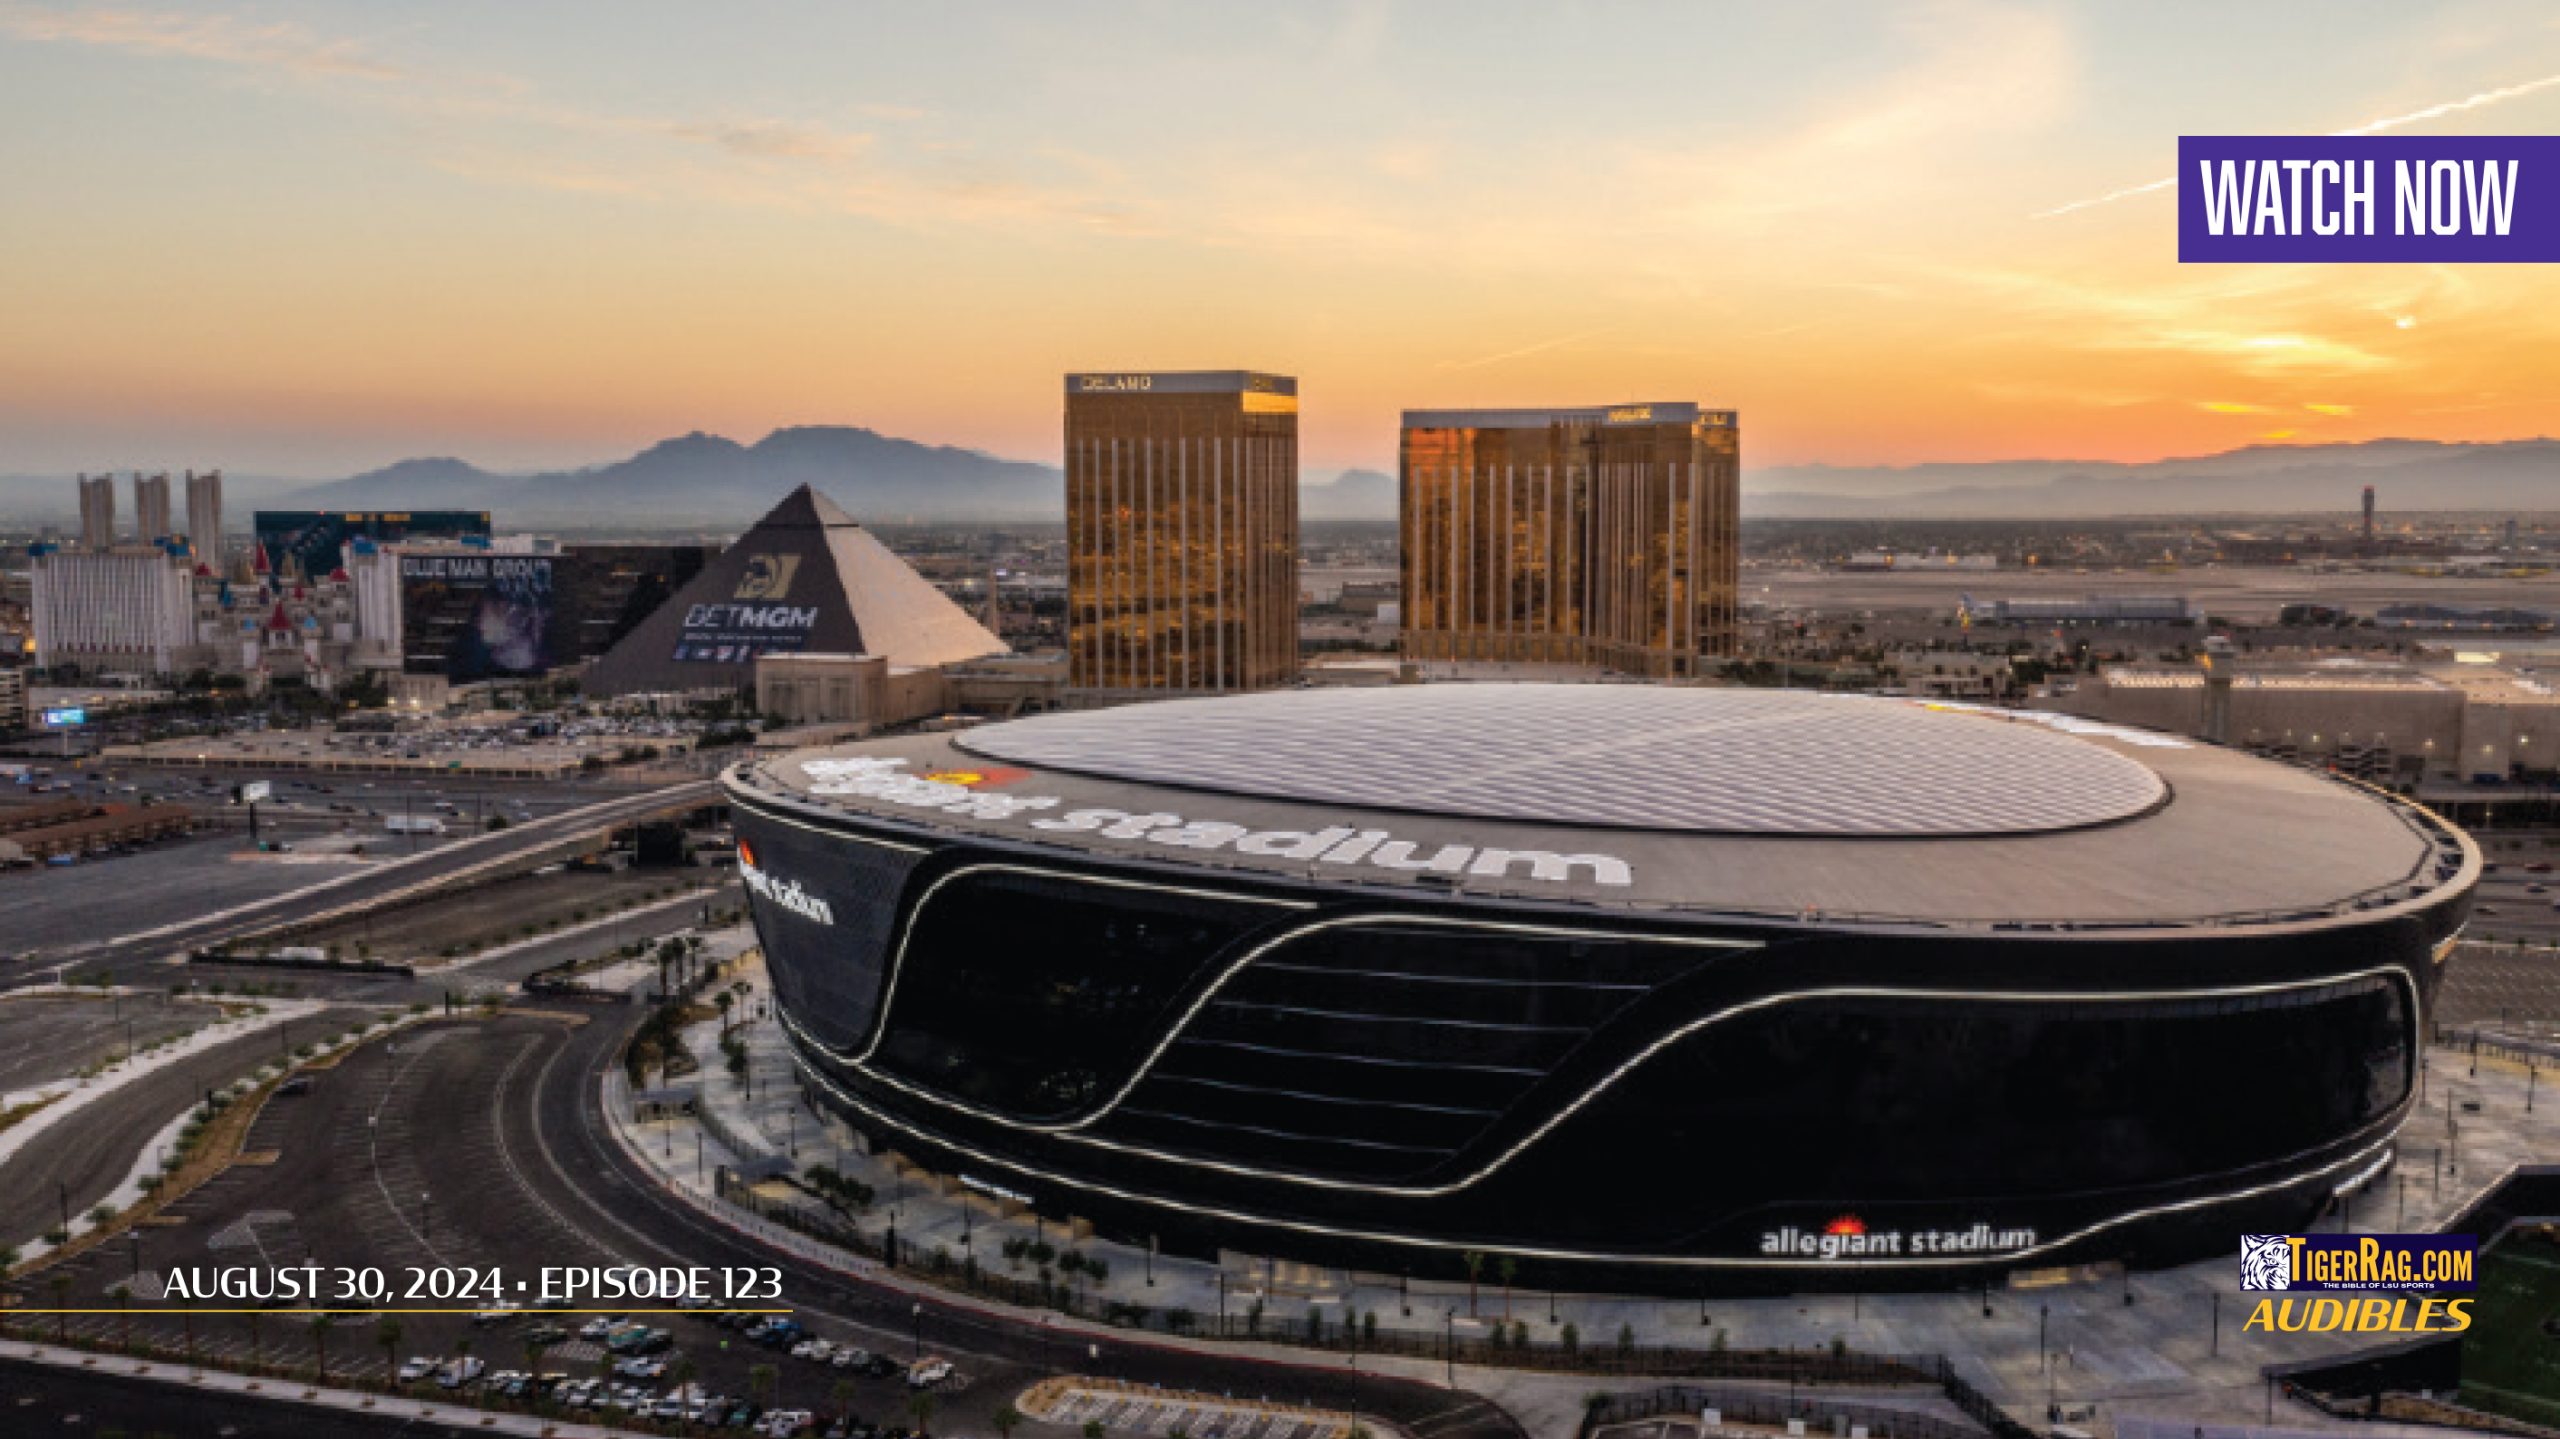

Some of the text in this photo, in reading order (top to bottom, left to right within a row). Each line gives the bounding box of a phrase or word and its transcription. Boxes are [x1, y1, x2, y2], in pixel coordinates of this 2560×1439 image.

[403, 558, 446, 576] BLUE
[449, 558, 487, 577] MAN
[1030, 808, 1632, 885] stadium
[1761, 1223, 2036, 1259] allegiant stadium
